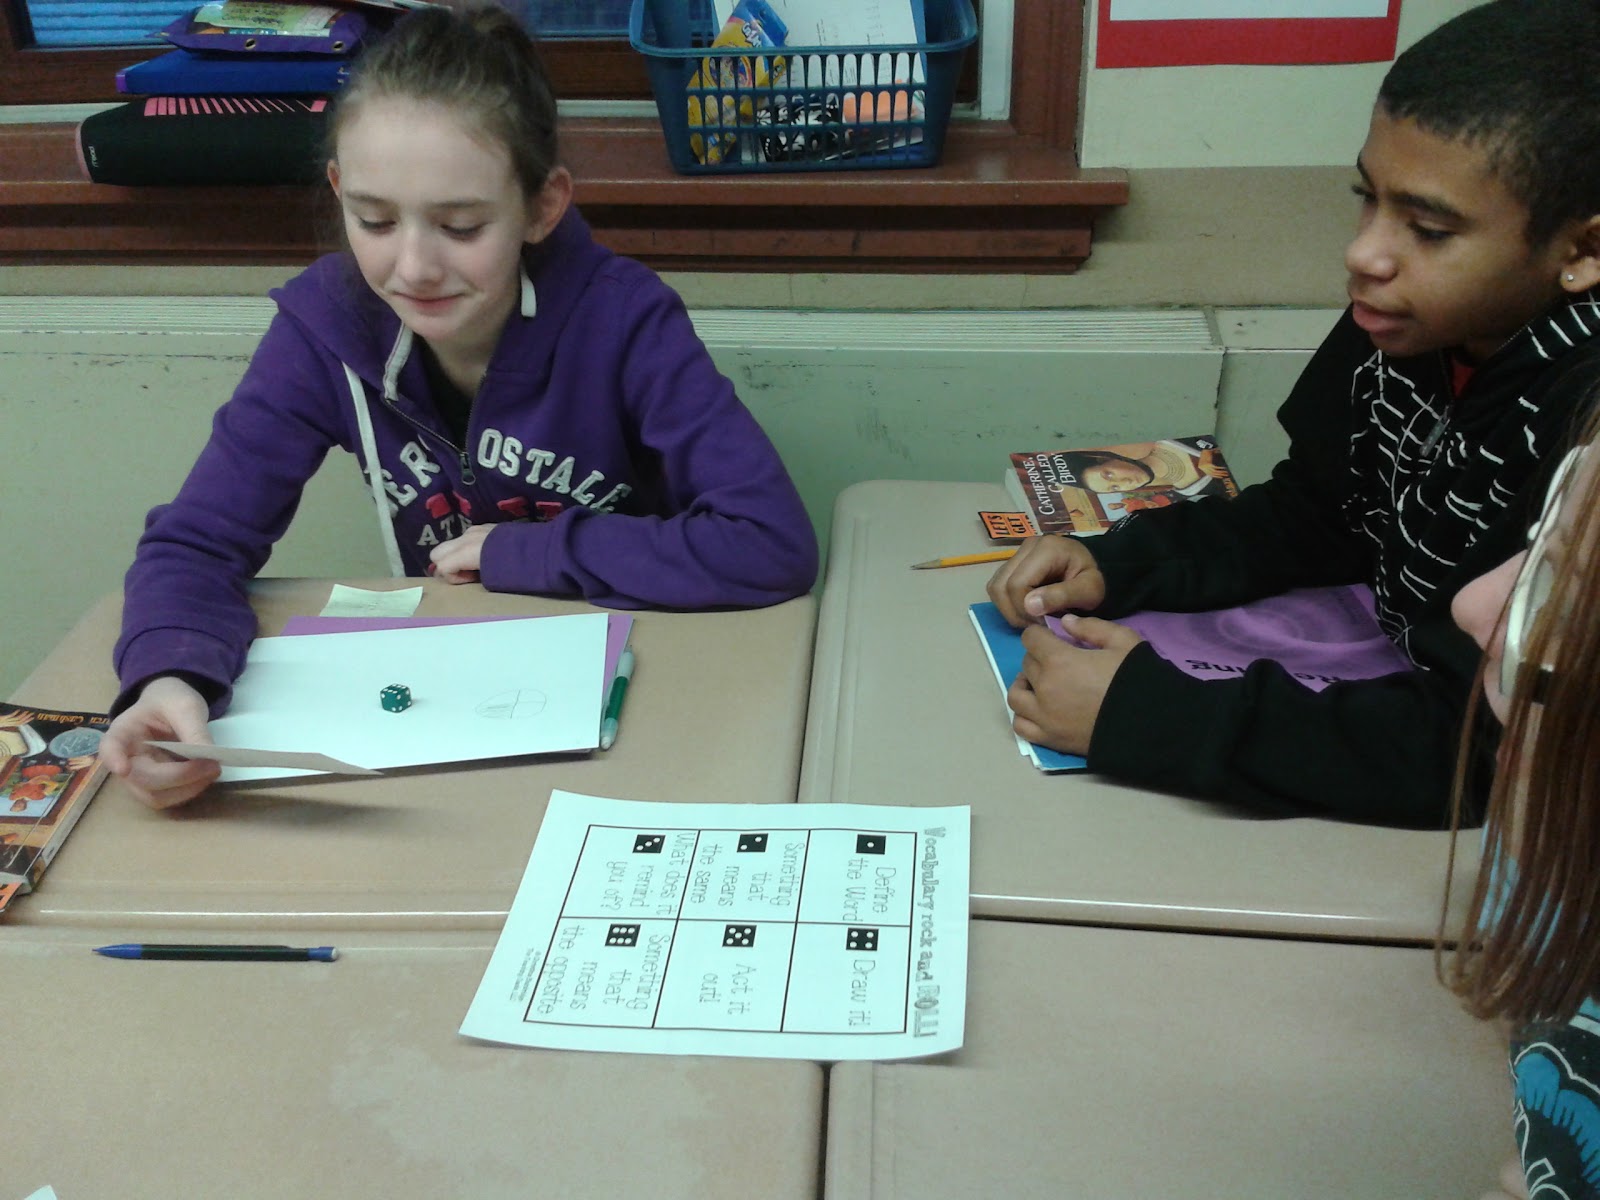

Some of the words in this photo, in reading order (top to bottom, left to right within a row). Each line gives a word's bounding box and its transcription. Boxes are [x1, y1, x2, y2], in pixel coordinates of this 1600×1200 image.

[1037, 453, 1065, 494] CALLED
[1051, 452, 1077, 485] BIRDY
[1011, 516, 1026, 535] GET
[669, 831, 697, 866] What
[699, 843, 724, 865] the
[606, 861, 628, 883] you
[660, 871, 685, 899] does
[769, 842, 806, 907] Something
[846, 858, 870, 880] the
[917, 826, 947, 911] Vocabulary
[600, 889, 624, 911] of?
[629, 864, 655, 908] remind
[690, 870, 711, 904] same
[717, 865, 741, 908] means
[747, 871, 773, 902] that
[872, 867, 897, 914] Define
[656, 904, 678, 916] it
[557, 924, 585, 950] the
[919, 913, 938, 948] rock
[625, 934, 671, 1011] Something
[731, 963, 757, 994] Act
[850, 959, 876, 1003] Draw
[915, 950, 934, 982] and
[536, 956, 569, 1015] opposite
[569, 960, 598, 1011] means
[602, 968, 632, 1006] that
[698, 972, 722, 1004] out!
[727, 999, 751, 1015] it
